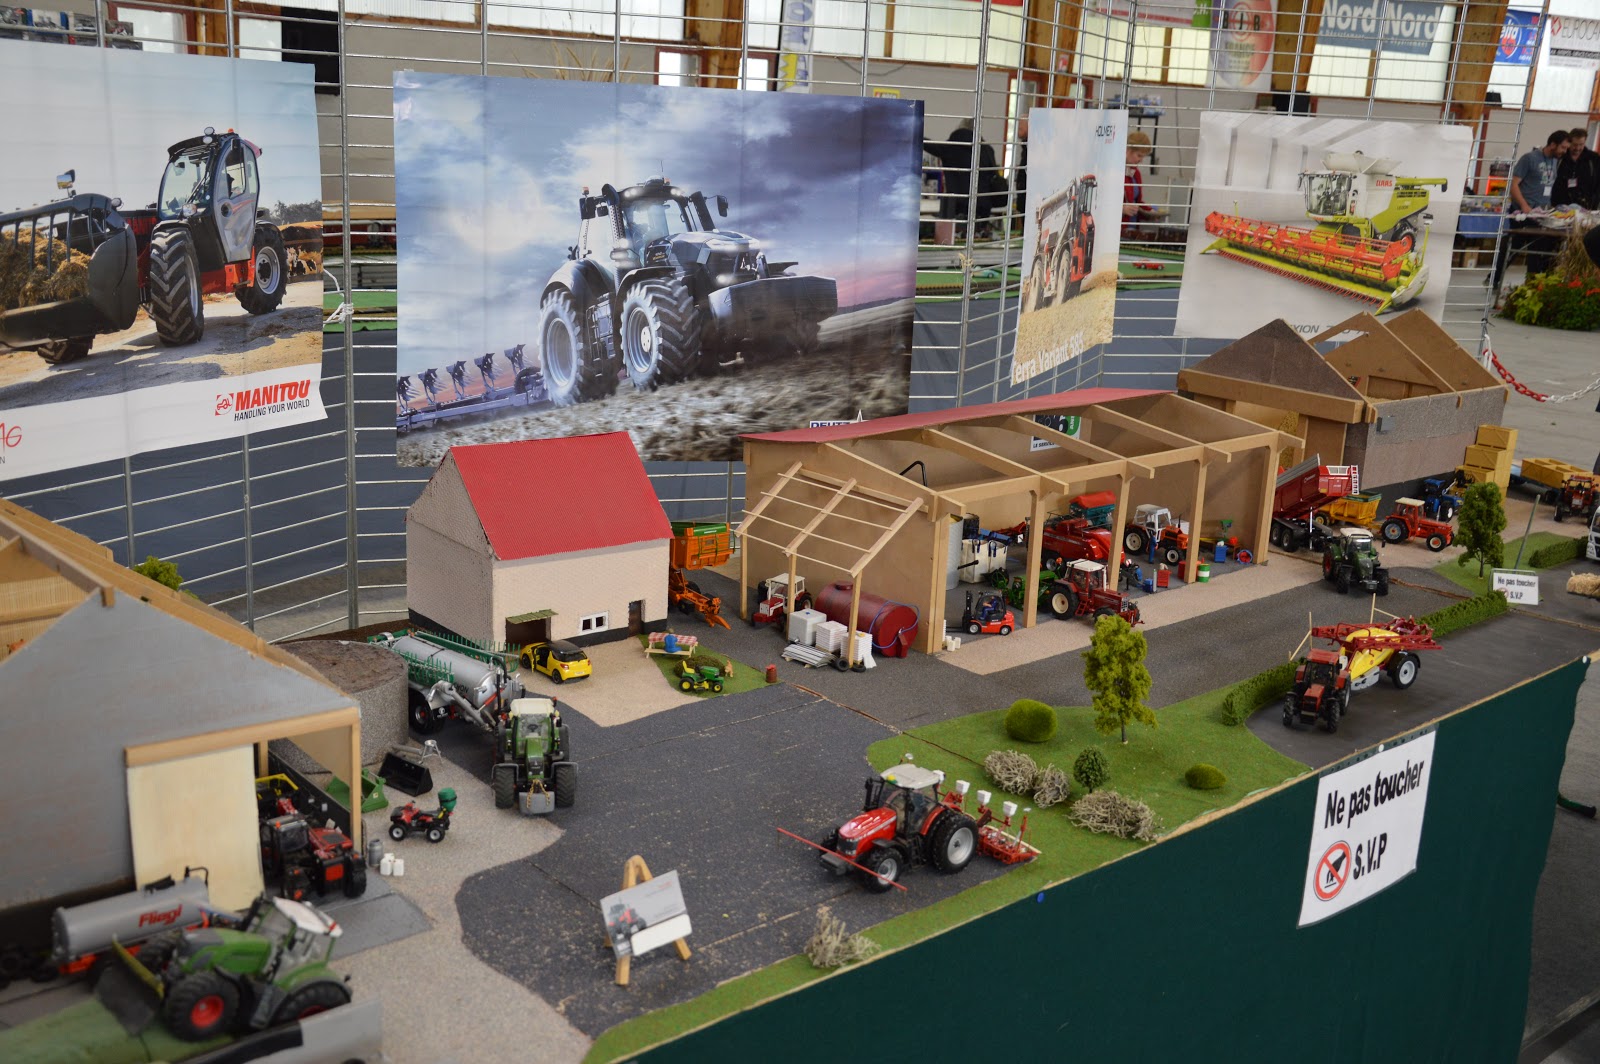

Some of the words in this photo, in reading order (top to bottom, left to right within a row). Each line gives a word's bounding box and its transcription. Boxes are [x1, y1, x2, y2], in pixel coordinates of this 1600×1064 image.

[1320, 0, 1378, 33] Nord
[1384, 2, 1440, 39] Nord
[1291, 324, 1320, 334] XION
[234, 406, 267, 421] HANDLING
[267, 402, 286, 414] YOUR
[286, 398, 310, 410] WORLD
[235, 379, 311, 412] MANITOU
[1497, 576, 1505, 584] Ne
[1506, 579, 1515, 587] pas
[1516, 578, 1536, 588] toucher
[1324, 790, 1345, 829] Ne
[1347, 784, 1371, 829] pas
[1374, 760, 1425, 807] toucher
[1353, 832, 1388, 880] S.V.P
[138, 904, 183, 929] Fliegl
